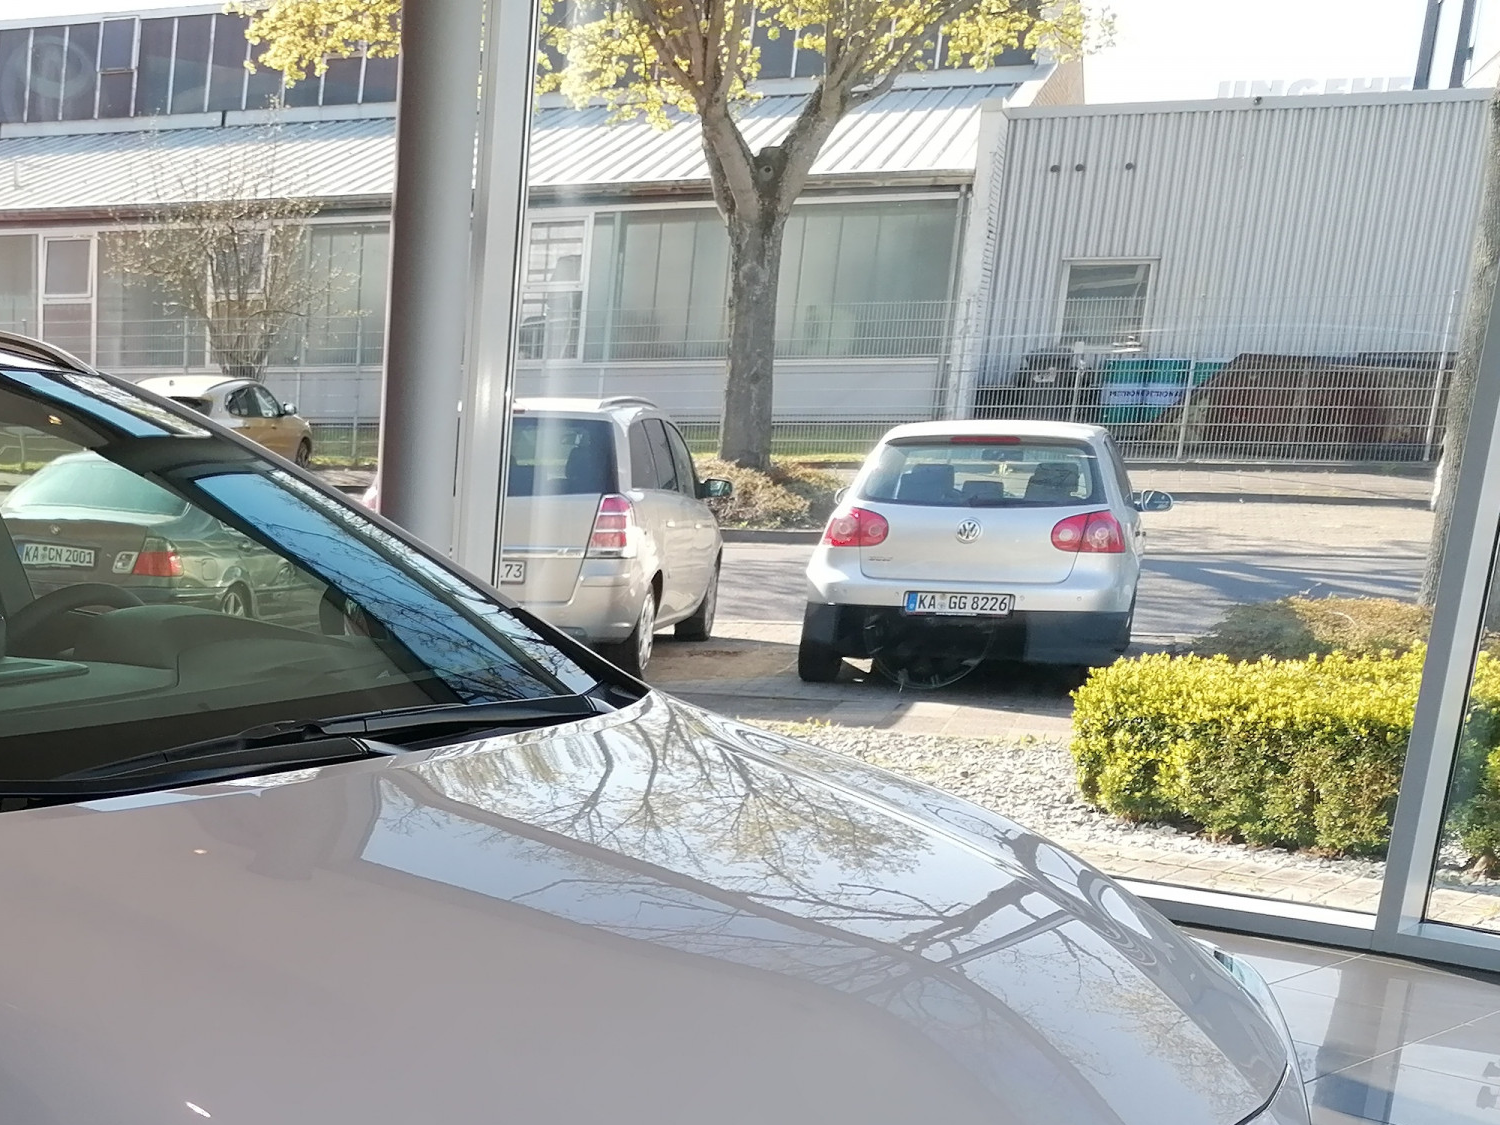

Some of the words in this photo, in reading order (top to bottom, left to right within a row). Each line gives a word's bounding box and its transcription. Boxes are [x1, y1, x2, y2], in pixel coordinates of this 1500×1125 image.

[24, 546, 39, 562] KA
[48, 548, 62, 562] CN
[65, 550, 93, 564] 2001
[501, 564, 523, 578] 73
[918, 595, 936, 609] KA
[949, 596, 967, 610] GG
[971, 597, 1007, 611] 8226
